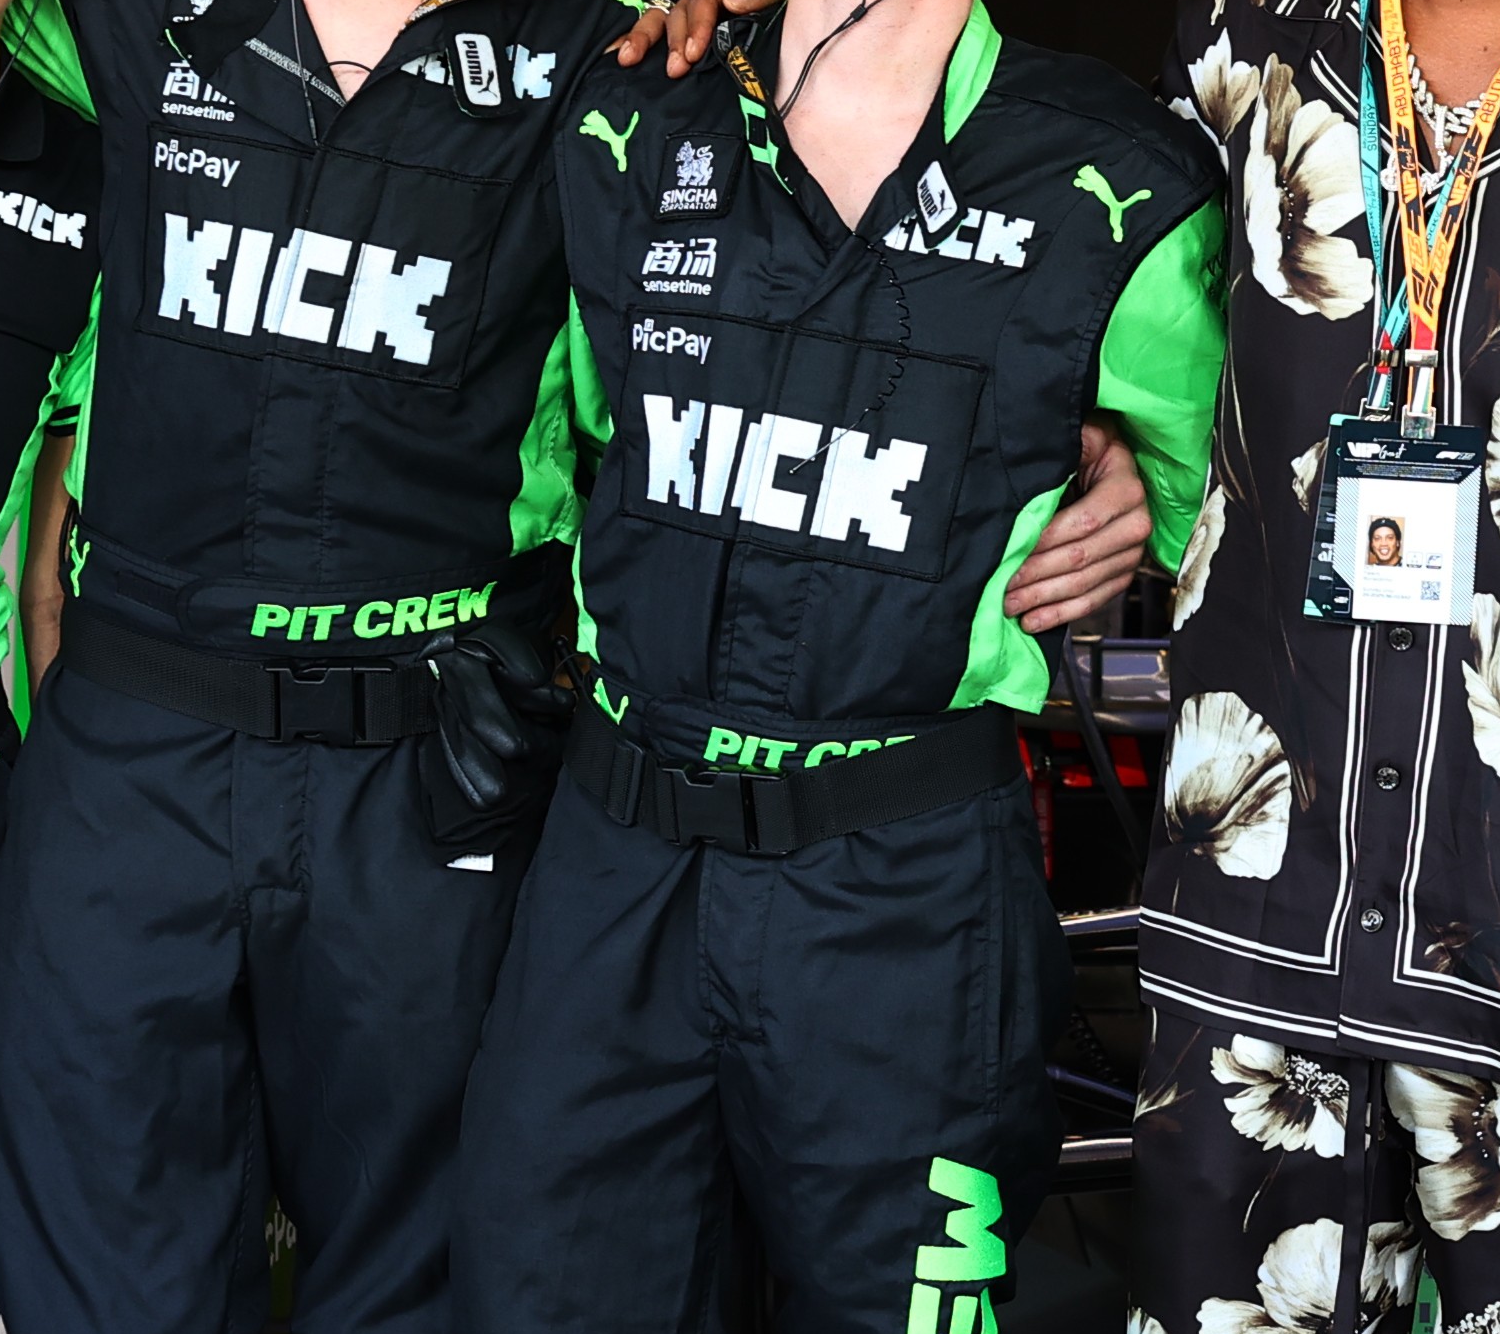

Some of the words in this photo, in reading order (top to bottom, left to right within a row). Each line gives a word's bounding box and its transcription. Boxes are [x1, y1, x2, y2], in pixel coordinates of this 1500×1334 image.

[462, 39, 483, 86] PUMA
[162, 101, 236, 123] sensetime
[1367, 104, 1378, 152] SUNDAY
[155, 139, 241, 187] PicPay
[662, 188, 718, 207] SINGHA
[1401, 172, 1419, 204] VIP
[1448, 177, 1467, 207] VIP
[642, 237, 718, 278] 商汤
[157, 212, 452, 366] KICK
[643, 279, 712, 297] sensetime
[632, 318, 712, 364] PicPay
[1346, 441, 1381, 458] VIP
[643, 394, 928, 553] KICK
[251, 603, 345, 643] PIT
[353, 581, 498, 639] CREW
[704, 727, 798, 768] PIT
